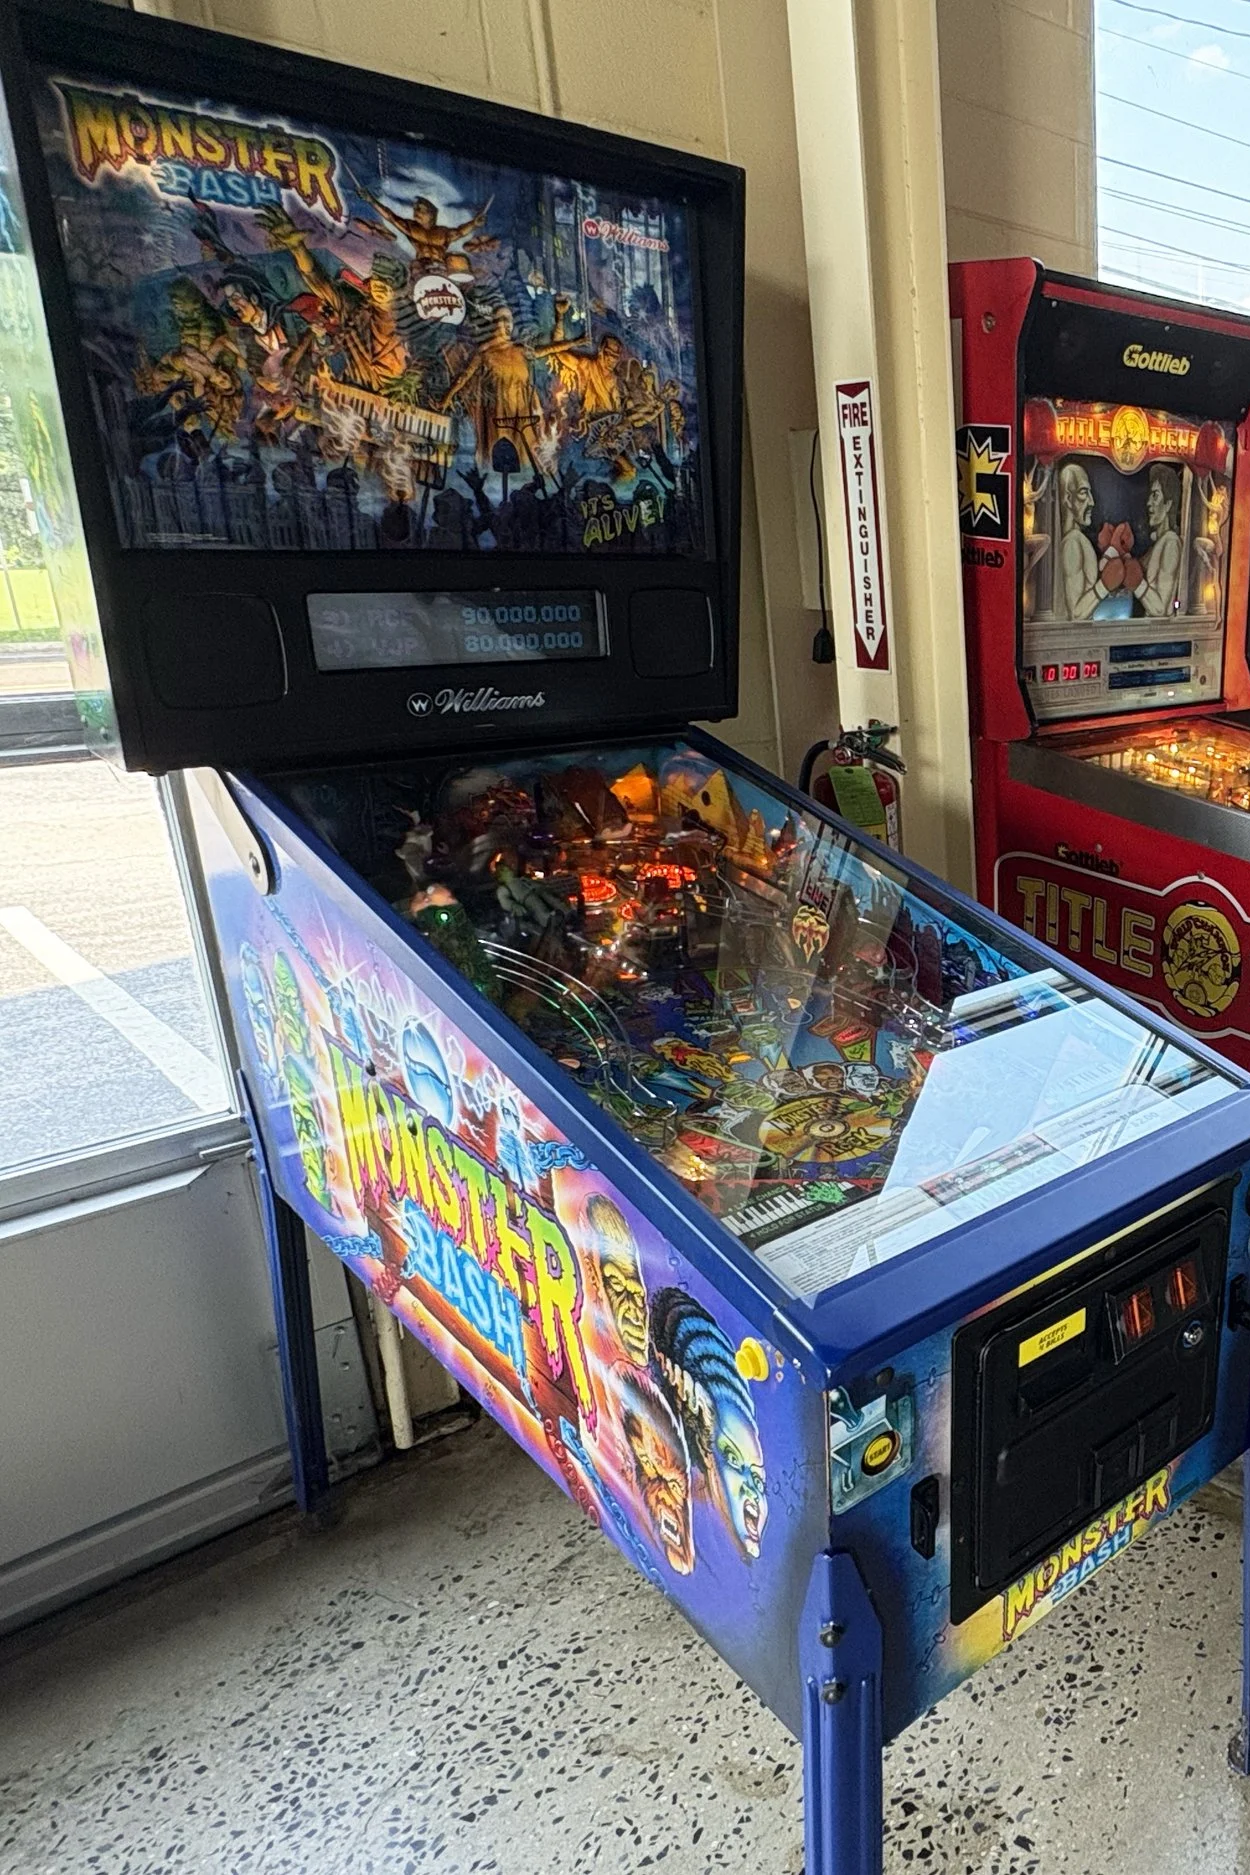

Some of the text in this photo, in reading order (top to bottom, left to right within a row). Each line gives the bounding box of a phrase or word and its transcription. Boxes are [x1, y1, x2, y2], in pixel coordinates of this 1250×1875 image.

[64, 83, 343, 222] MONSTER
[154, 162, 280, 205] BASH
[599, 221, 669, 251] Williams
[1123, 344, 1191, 376] Gottlieb
[841, 402, 869, 428] FIRE
[1056, 416, 1199, 457] TITLE FIGHT
[581, 495, 614, 518] IT'S
[583, 495, 664, 547] ALIVE!
[852, 436, 875, 640] EXTINGUISHER
[962, 546, 1005, 570] ttlieb
[462, 605, 581, 626] 90,000,000
[435, 687, 546, 715] Williams
[1055, 841, 1121, 877] Gottlieb
[1016, 876, 1156, 979] TITLE
[768, 1098, 847, 1137] MONSTER
[325, 1036, 598, 1442] MONSTER
[756, 1203, 827, 1236] HOLD FOR STATUS
[401, 1203, 526, 1372] BASH
[1038, 1323, 1068, 1345] ACCEPTS
[1004, 1467, 1171, 1641] MONSTER
[1051, 1522, 1133, 1602] BASH
